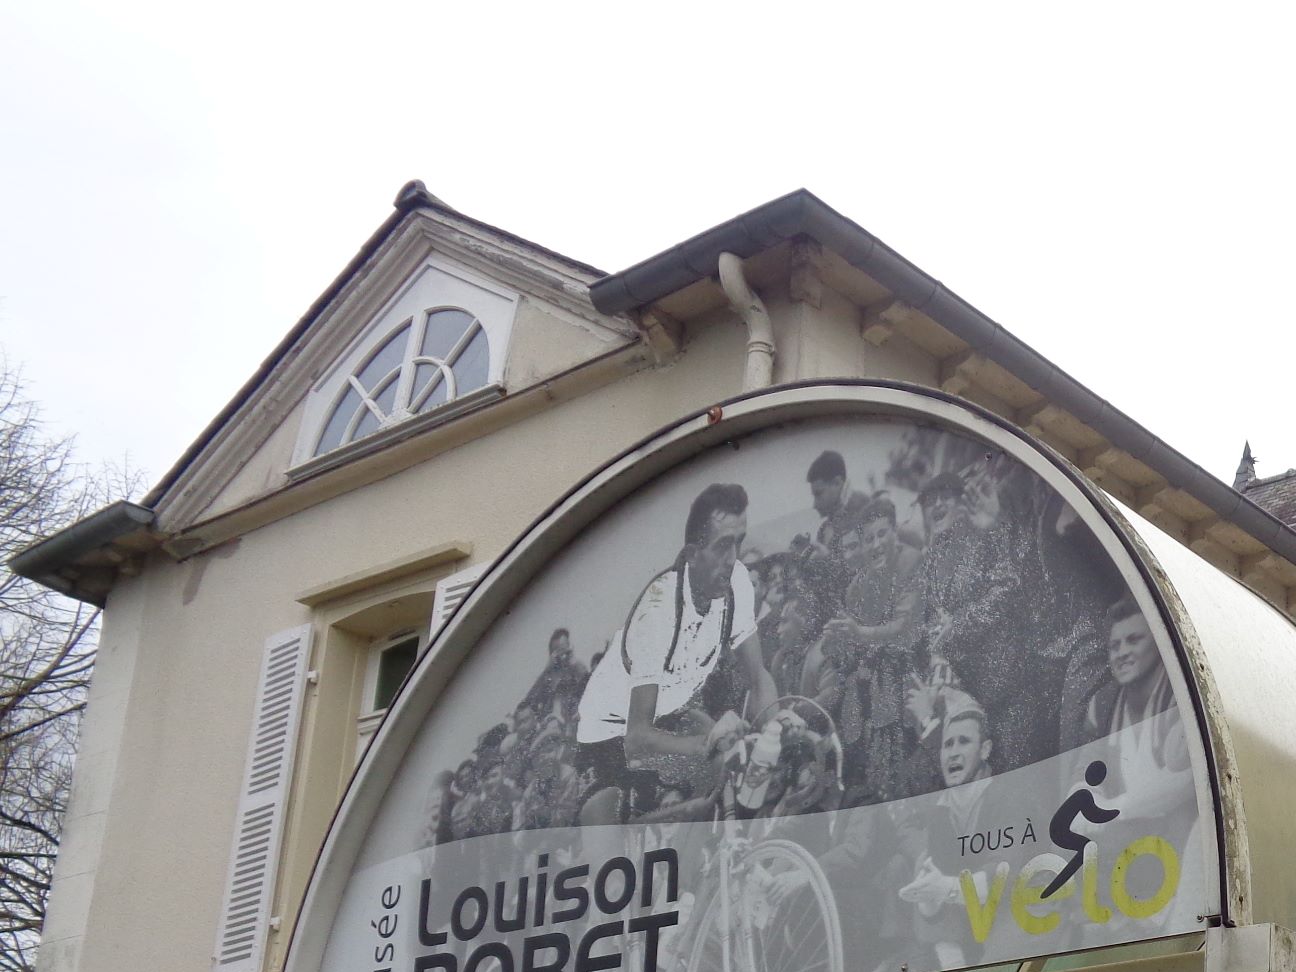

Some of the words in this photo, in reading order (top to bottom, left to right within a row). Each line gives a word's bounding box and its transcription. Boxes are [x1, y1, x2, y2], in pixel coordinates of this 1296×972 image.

[957, 827, 1014, 857] TOUS
[1021, 818, 1037, 845] À
[418, 847, 679, 947] Louison
